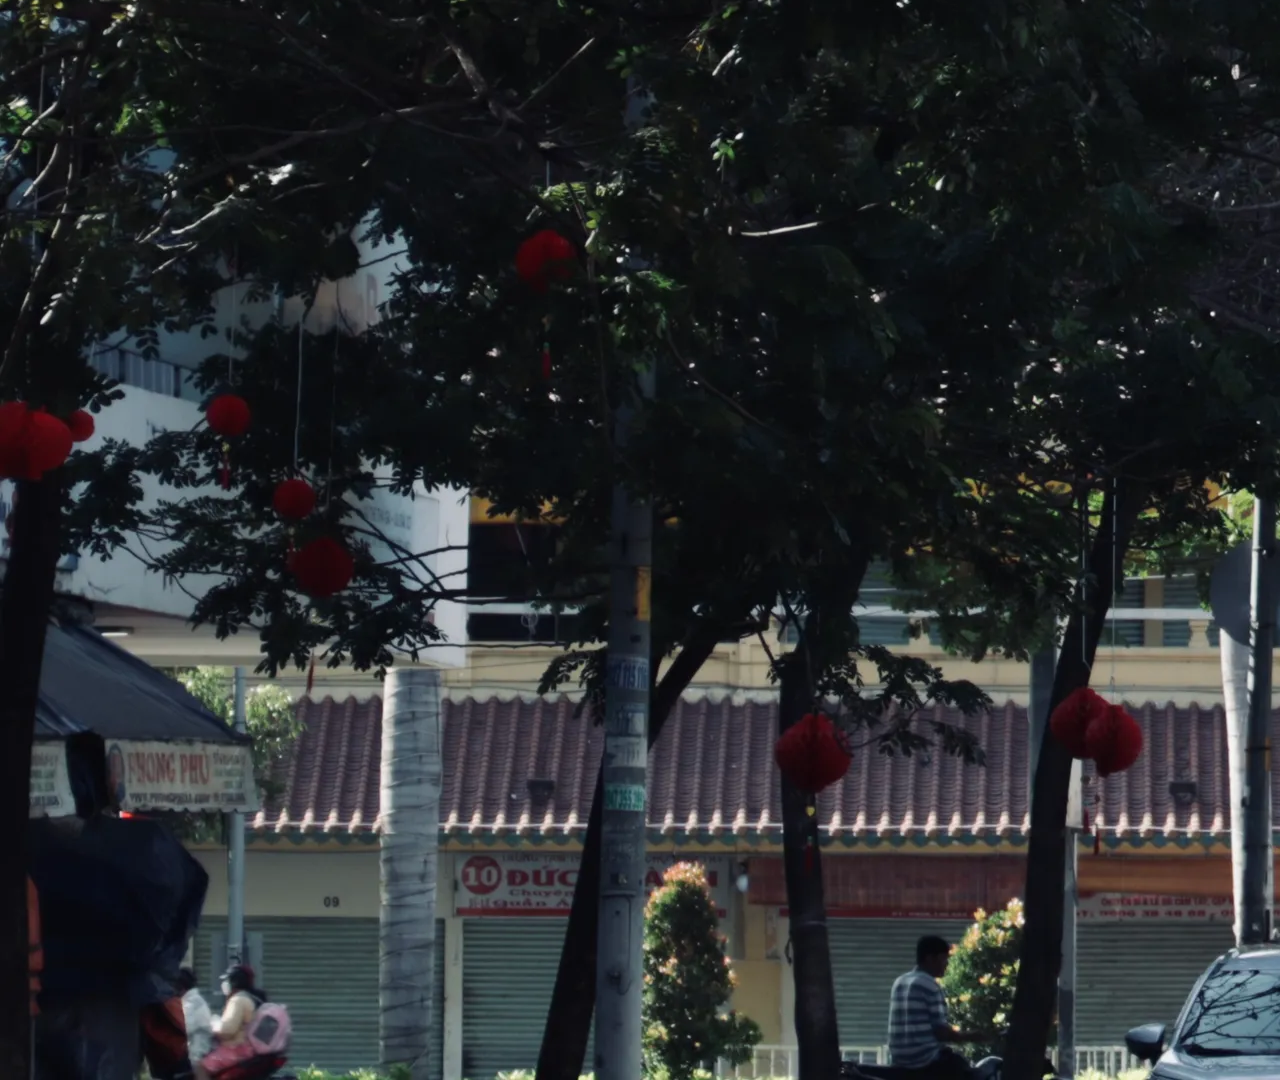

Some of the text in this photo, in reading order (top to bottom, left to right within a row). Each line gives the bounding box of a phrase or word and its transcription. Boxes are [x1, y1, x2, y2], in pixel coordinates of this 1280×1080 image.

[127, 752, 176, 784] PHONG
[464, 866, 498, 887] 10
[323, 896, 340, 908] 09
